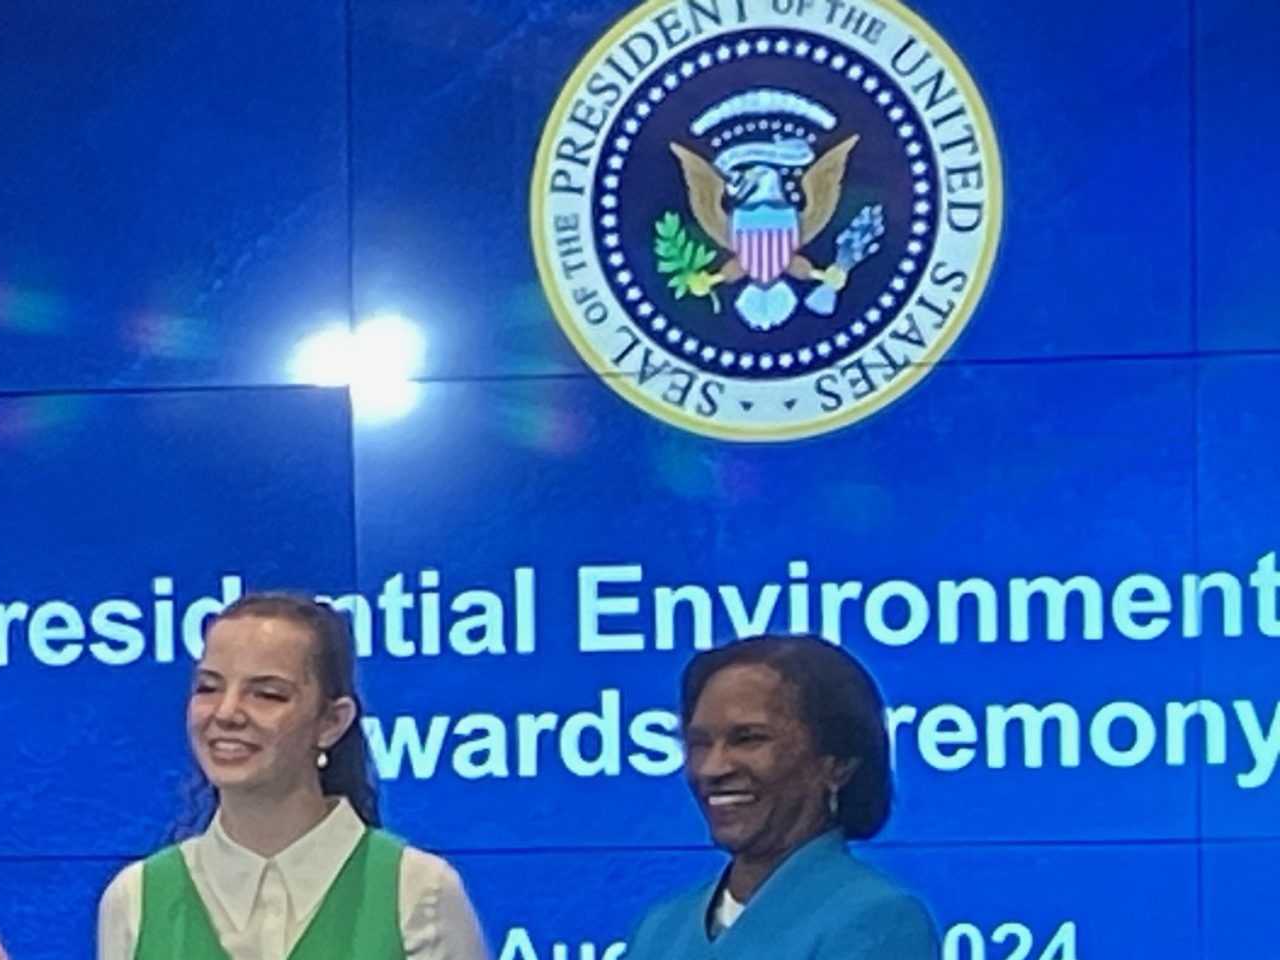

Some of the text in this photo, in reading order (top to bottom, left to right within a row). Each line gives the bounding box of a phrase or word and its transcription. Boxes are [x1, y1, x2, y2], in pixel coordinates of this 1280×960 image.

[825, 0, 887, 45] THE
[890, 36, 983, 234] UNITED
[555, 212, 588, 280] THE
[574, 285, 609, 326] OF
[815, 261, 966, 416] STATES
[610, 326, 724, 417] SEAL
[362, 687, 1280, 789] wards remony
